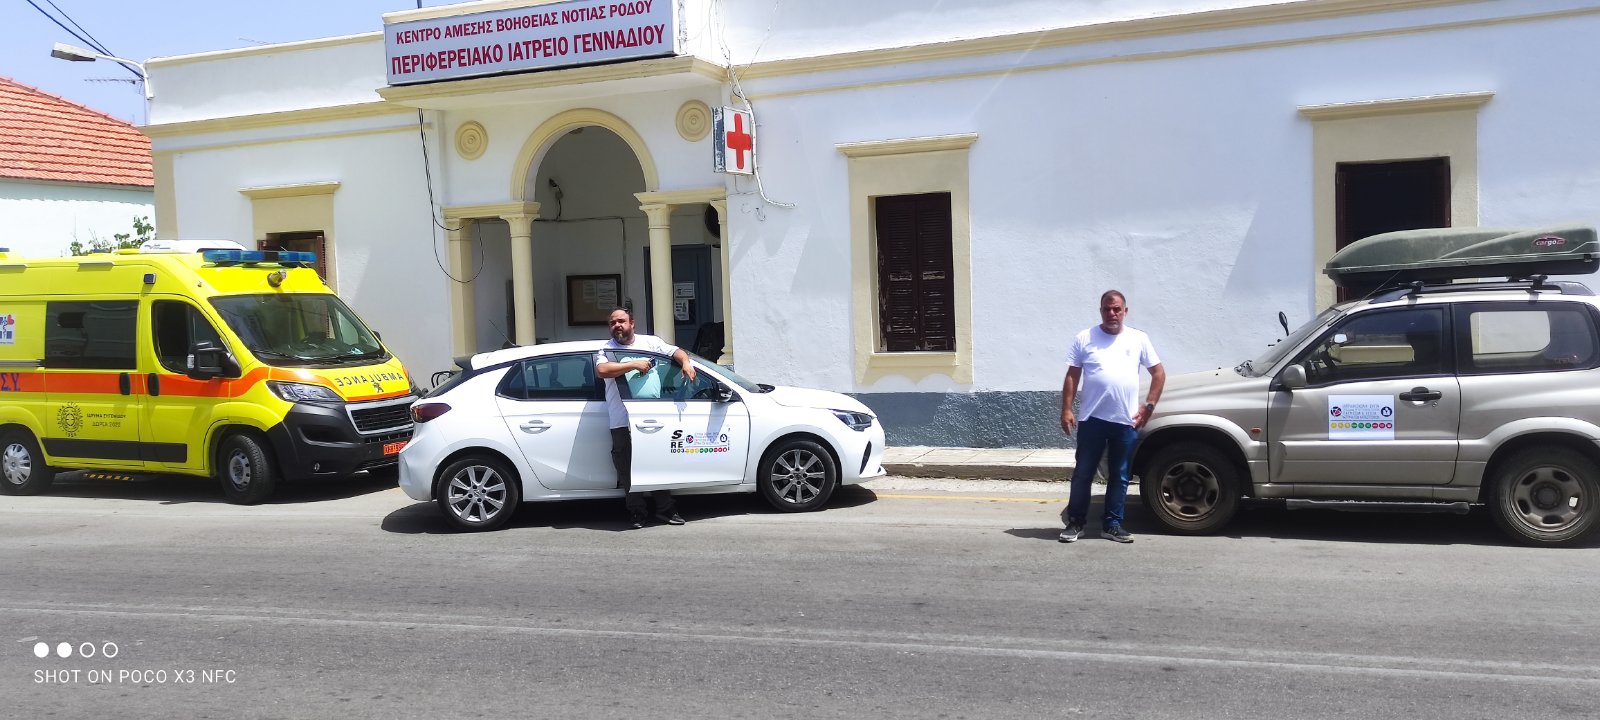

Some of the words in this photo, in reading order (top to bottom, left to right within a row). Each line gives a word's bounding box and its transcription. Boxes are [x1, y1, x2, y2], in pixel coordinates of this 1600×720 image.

[396, 27, 441, 45] ΚΕΝΤΡΟ
[444, 20, 493, 39] ΑΜΕΣΗΣ
[496, 11, 558, 32] ΒΟΗΘΕΙΑΣ
[561, 6, 606, 24] ΝΟΤΙΑΣ
[610, 0, 653, 19] ΡΟΔΟΥ
[391, 43, 504, 75] ΠΕΡΙΦΕΡΕΙΑΚΟ
[508, 36, 569, 61] ΙΑΤΡΕΙΟ
[573, 24, 666, 53] ΓΕΝΝΑΔΙΟΥ
